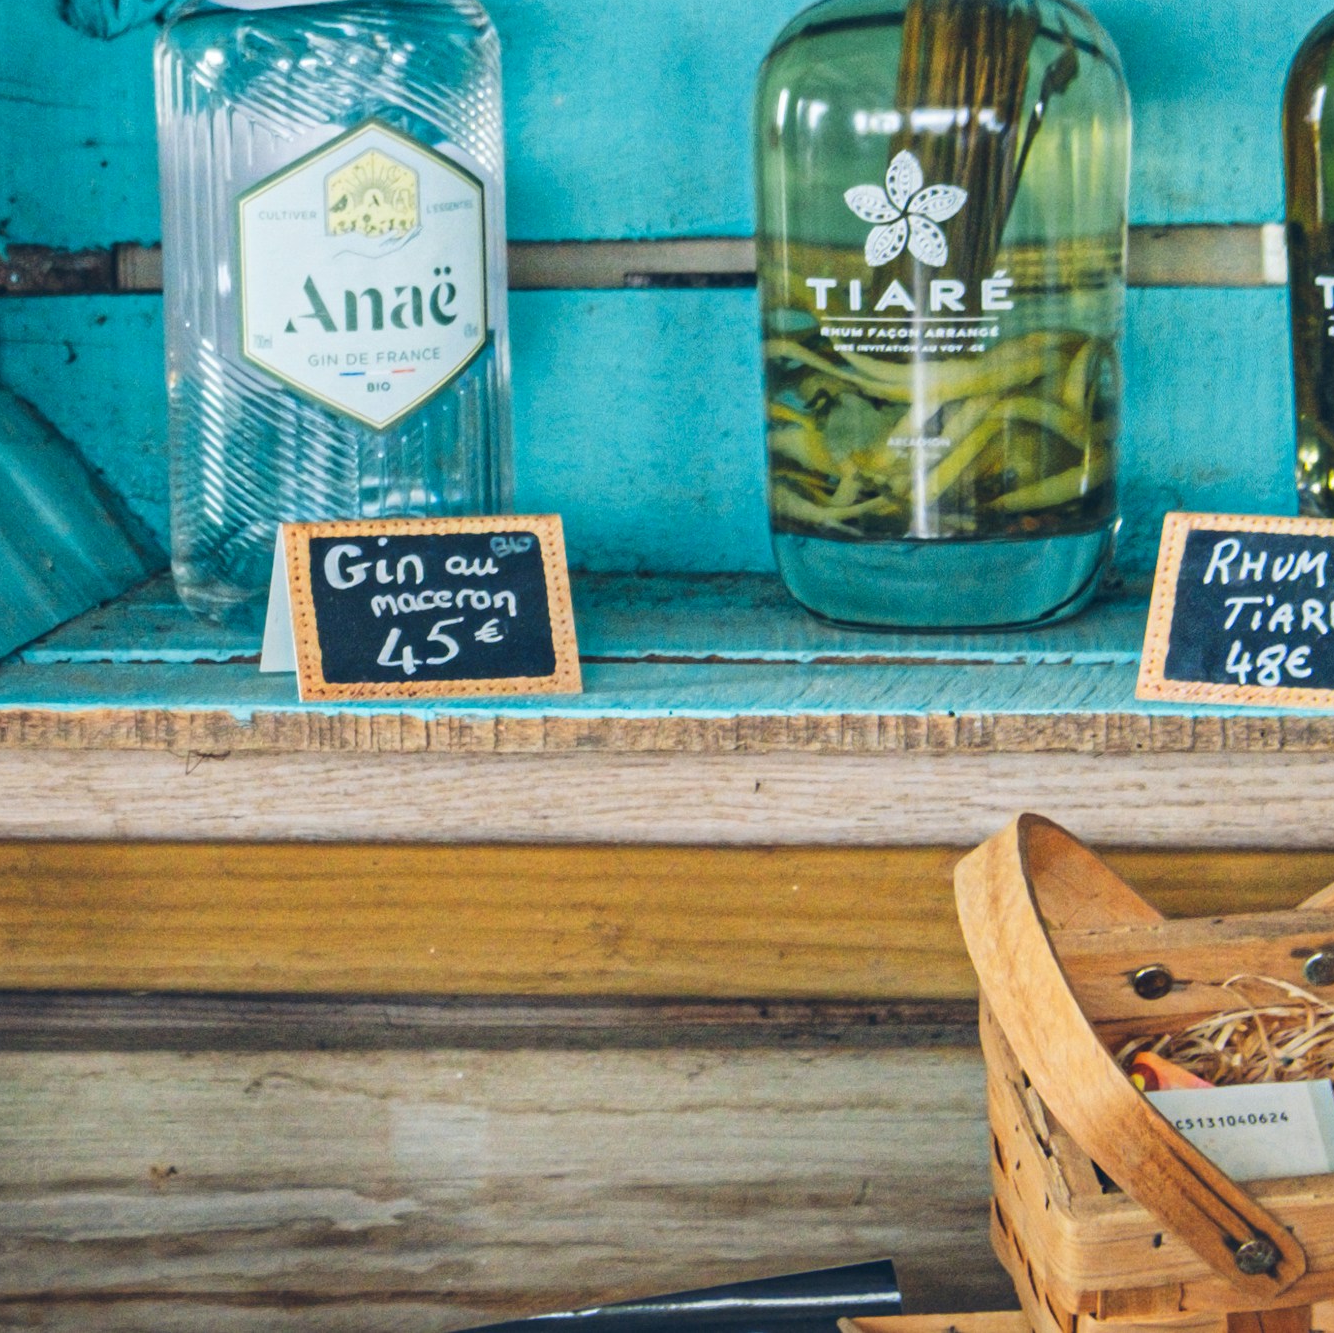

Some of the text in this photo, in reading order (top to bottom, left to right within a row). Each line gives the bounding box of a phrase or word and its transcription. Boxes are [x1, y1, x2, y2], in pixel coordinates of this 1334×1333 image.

[258, 209, 318, 221] CULTIVER
[283, 265, 459, 335] Anaë
[804, 269, 1016, 313] TIARÉ
[819, 323, 1001, 341] RHUM FAÇON ARRANGÉ
[307, 346, 442, 367] GIN DE FRANCE
[366, 381, 392, 393] BIO
[323, 536, 426, 591] Gin
[444, 554, 500, 578] au
[1202, 537, 1329, 589] RHUM
[369, 587, 517, 618] maceron
[1225, 639, 1313, 688] 48€
